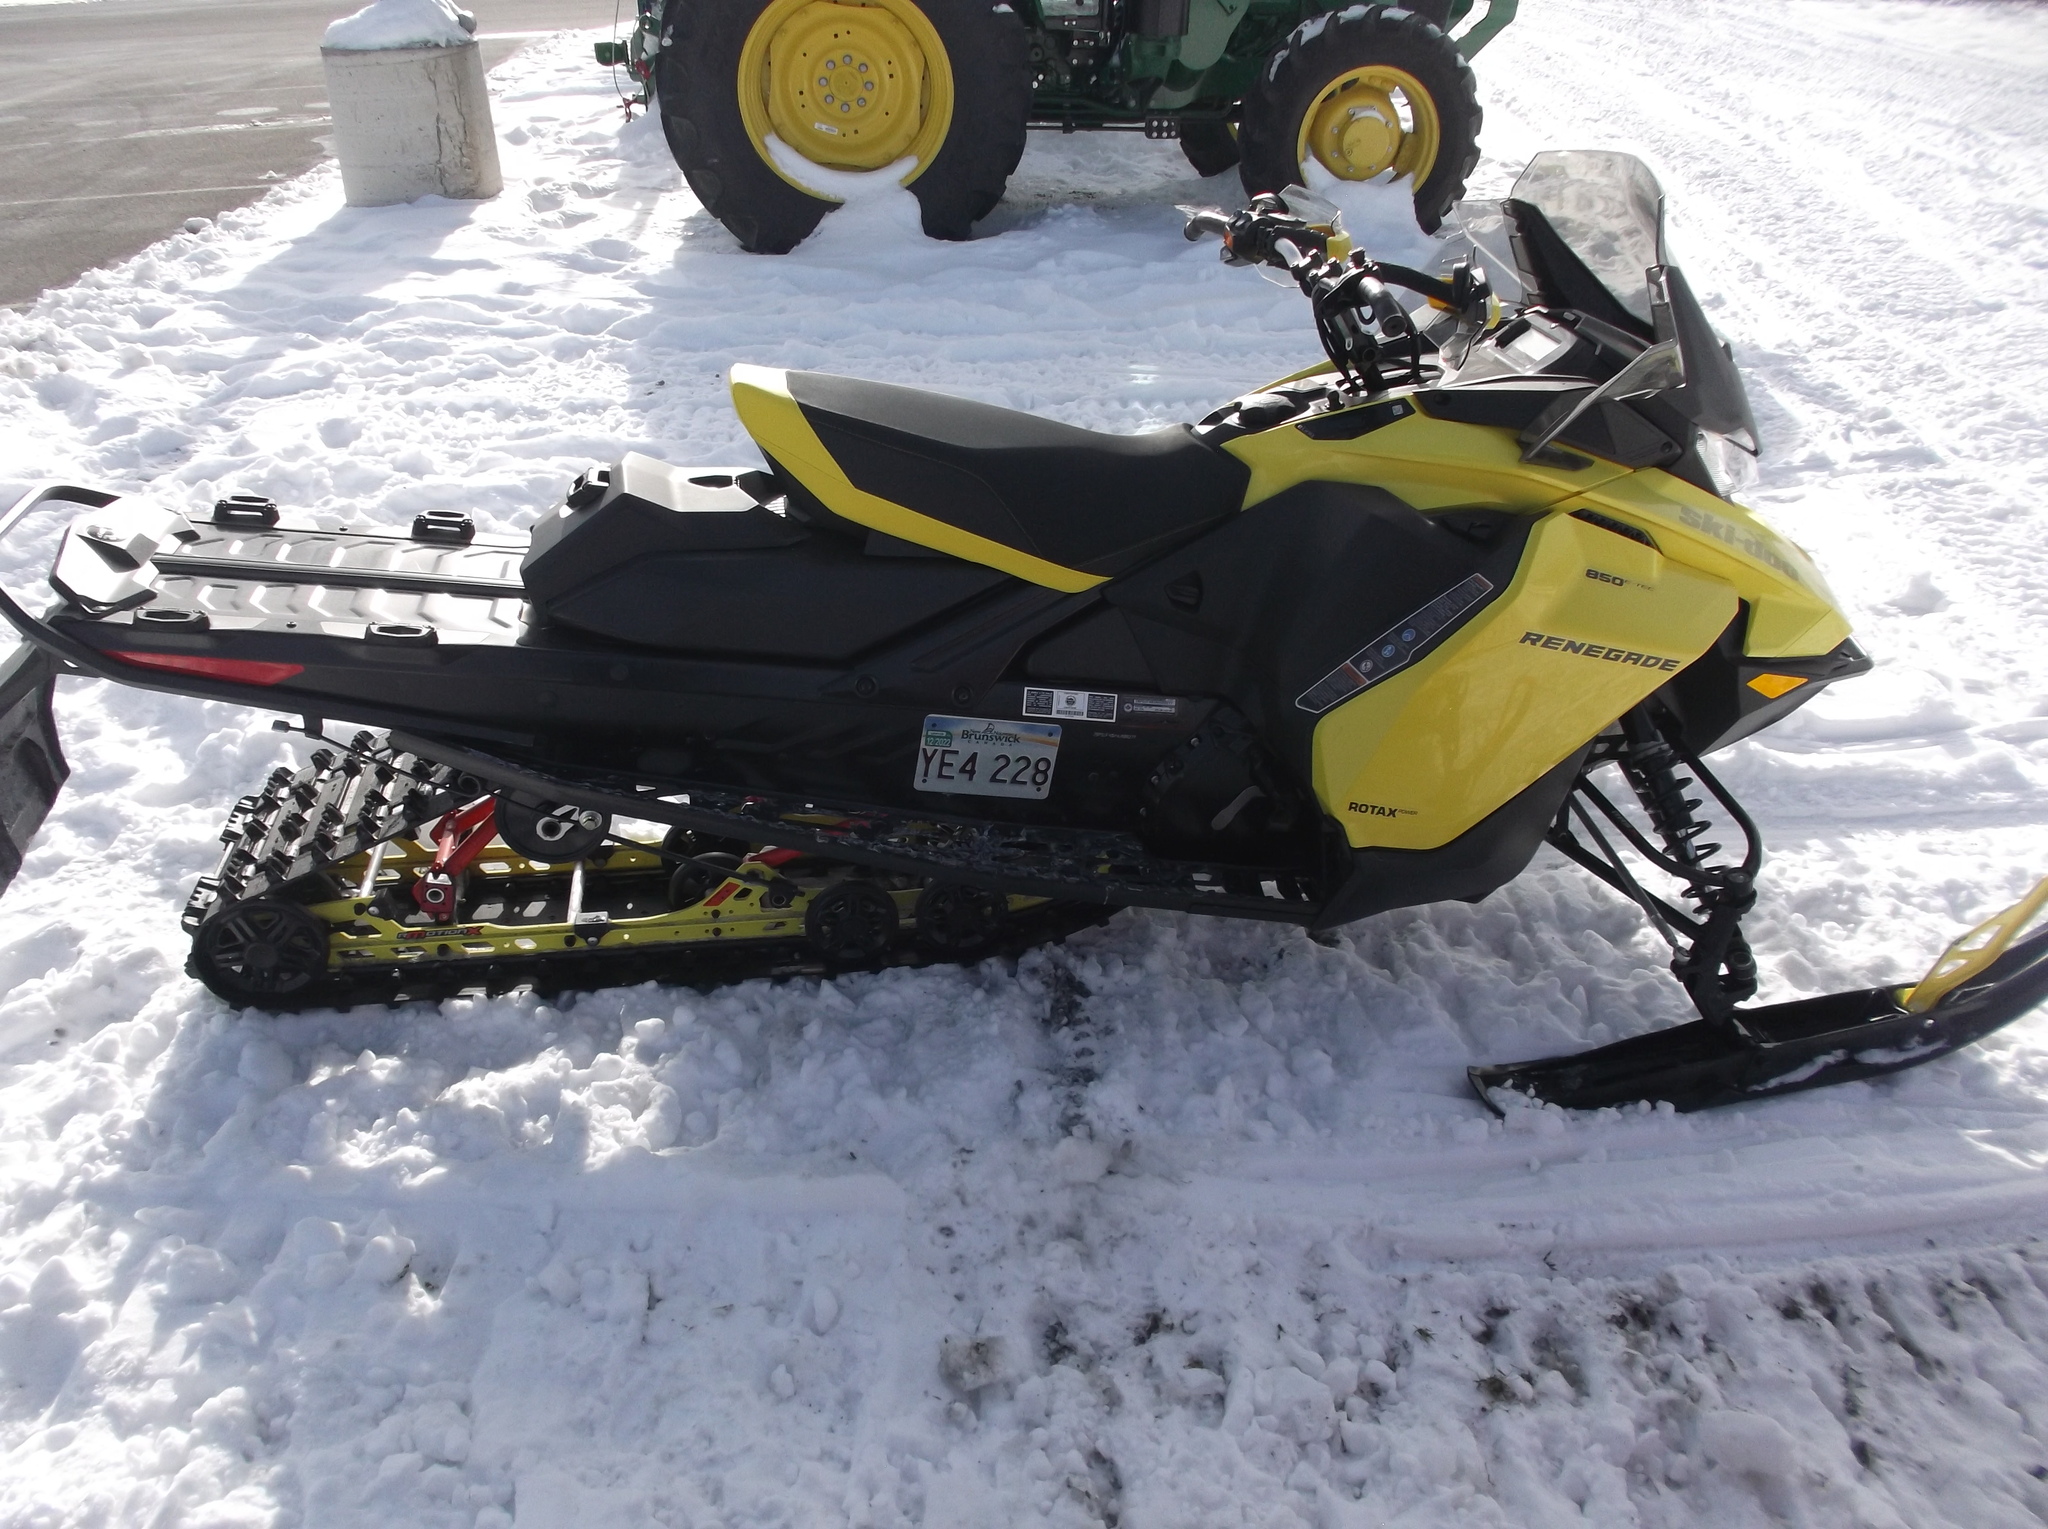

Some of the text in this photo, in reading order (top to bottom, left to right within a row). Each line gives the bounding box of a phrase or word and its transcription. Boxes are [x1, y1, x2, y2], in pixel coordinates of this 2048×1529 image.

[1585, 568, 1624, 587] 850
[1518, 631, 1681, 672] RENEGADE
[961, 729, 1021, 744] Brunswick
[922, 747, 1052, 786] YE4 228
[1348, 801, 1398, 818] ROTAX
